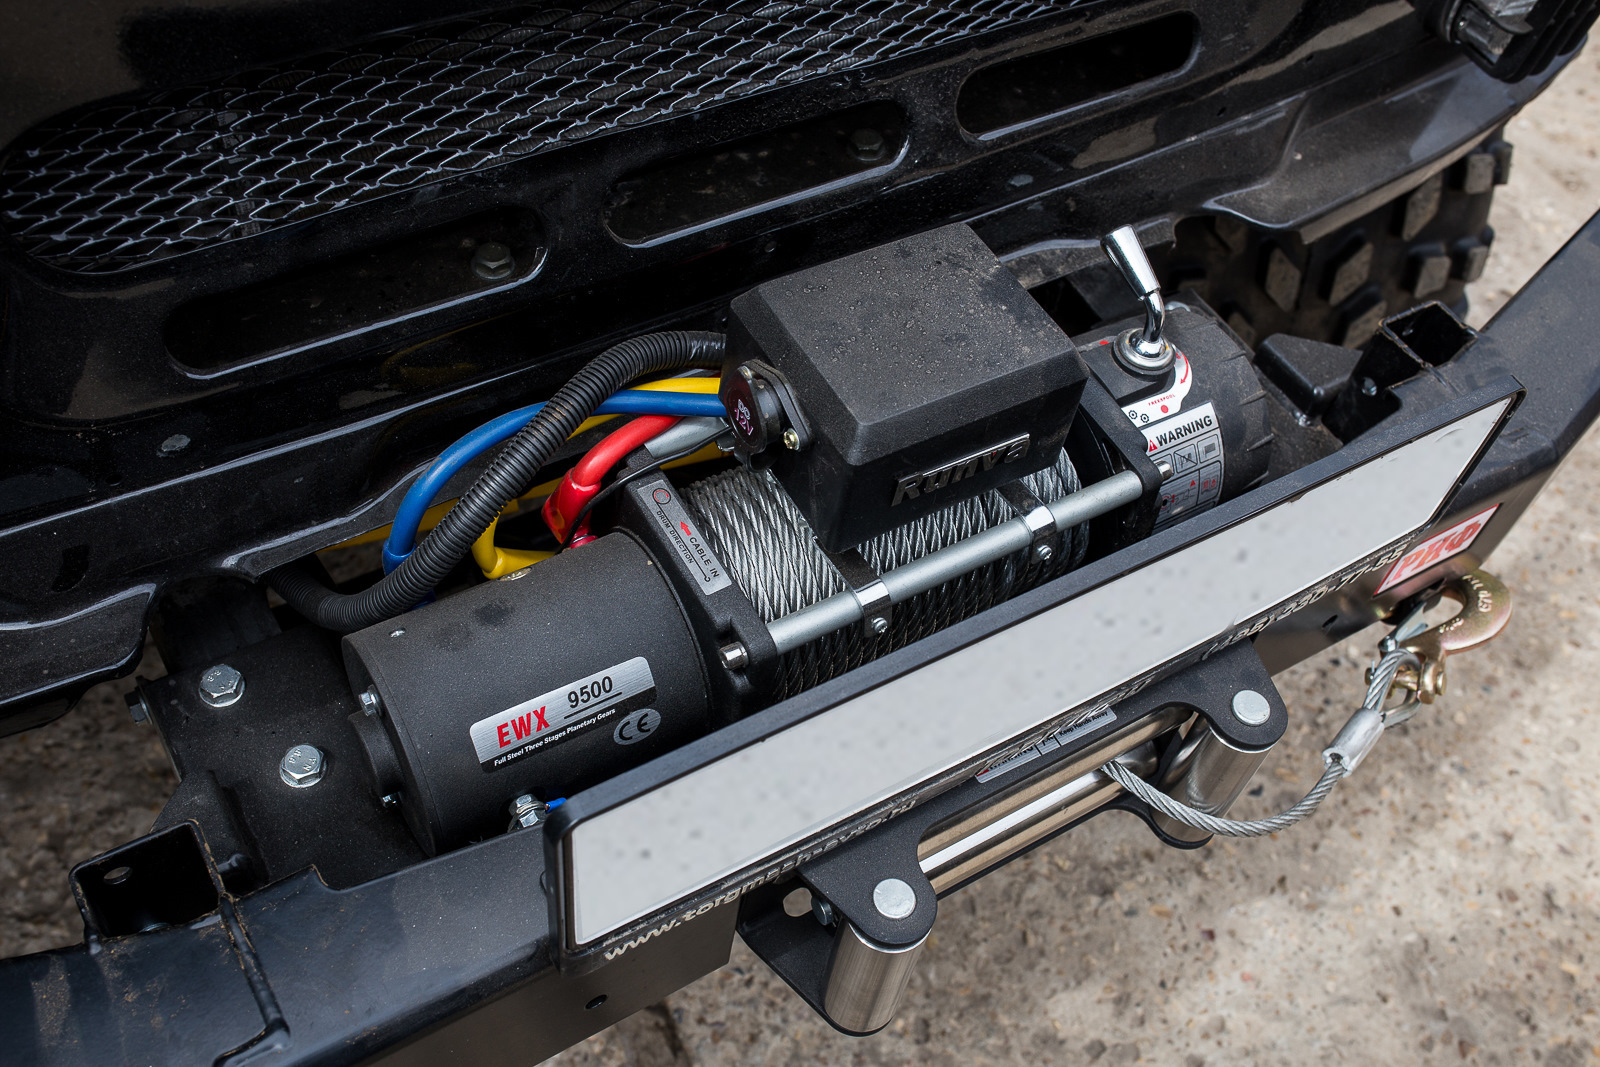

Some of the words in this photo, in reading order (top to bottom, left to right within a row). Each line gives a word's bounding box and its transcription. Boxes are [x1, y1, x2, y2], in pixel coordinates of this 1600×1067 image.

[734, 407, 754, 436] 12V
[1155, 415, 1213, 447] WARNING
[891, 433, 1031, 507] Runva
[656, 510, 671, 530] DRUM
[669, 529, 694, 564] DIRECTION
[689, 536, 712, 567] CABLE
[709, 567, 720, 578] IN
[496, 705, 551, 749] EWX
[567, 675, 614, 709] 9500
[618, 712, 651, 741] CE
[1059, 724, 1075, 737] Keep
[1073, 717, 1092, 730] Hands
[1091, 709, 1109, 722] Away
[494, 756, 507, 767] Full
[507, 749, 524, 762] Steel
[525, 740, 544, 754] Three
[544, 730, 567, 745] Stages
[566, 717, 597, 735] Planetary
[597, 708, 616, 721] Gears
